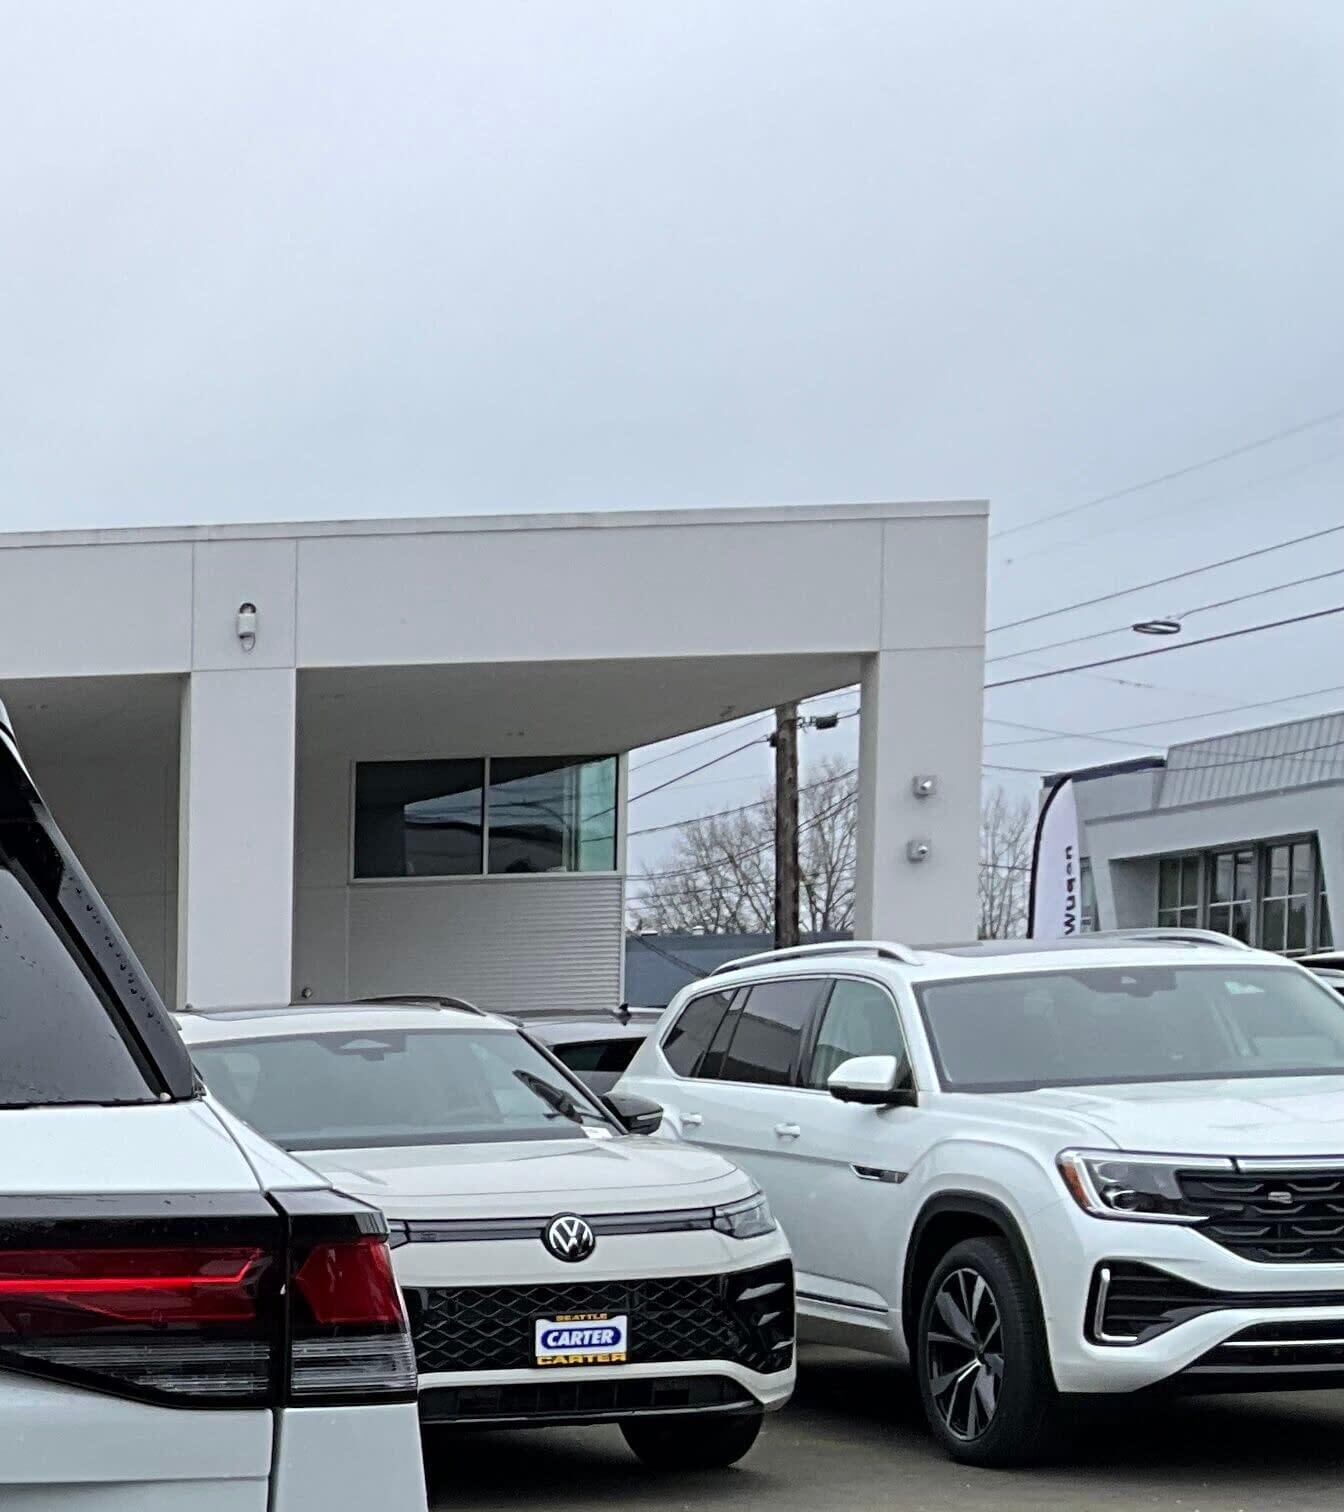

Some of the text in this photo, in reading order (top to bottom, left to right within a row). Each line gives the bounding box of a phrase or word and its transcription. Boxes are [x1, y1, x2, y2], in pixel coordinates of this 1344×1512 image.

[555, 1313, 608, 1322] SEATTLE
[547, 1329, 614, 1347] CARTER
[537, 1352, 626, 1365] CARTER
